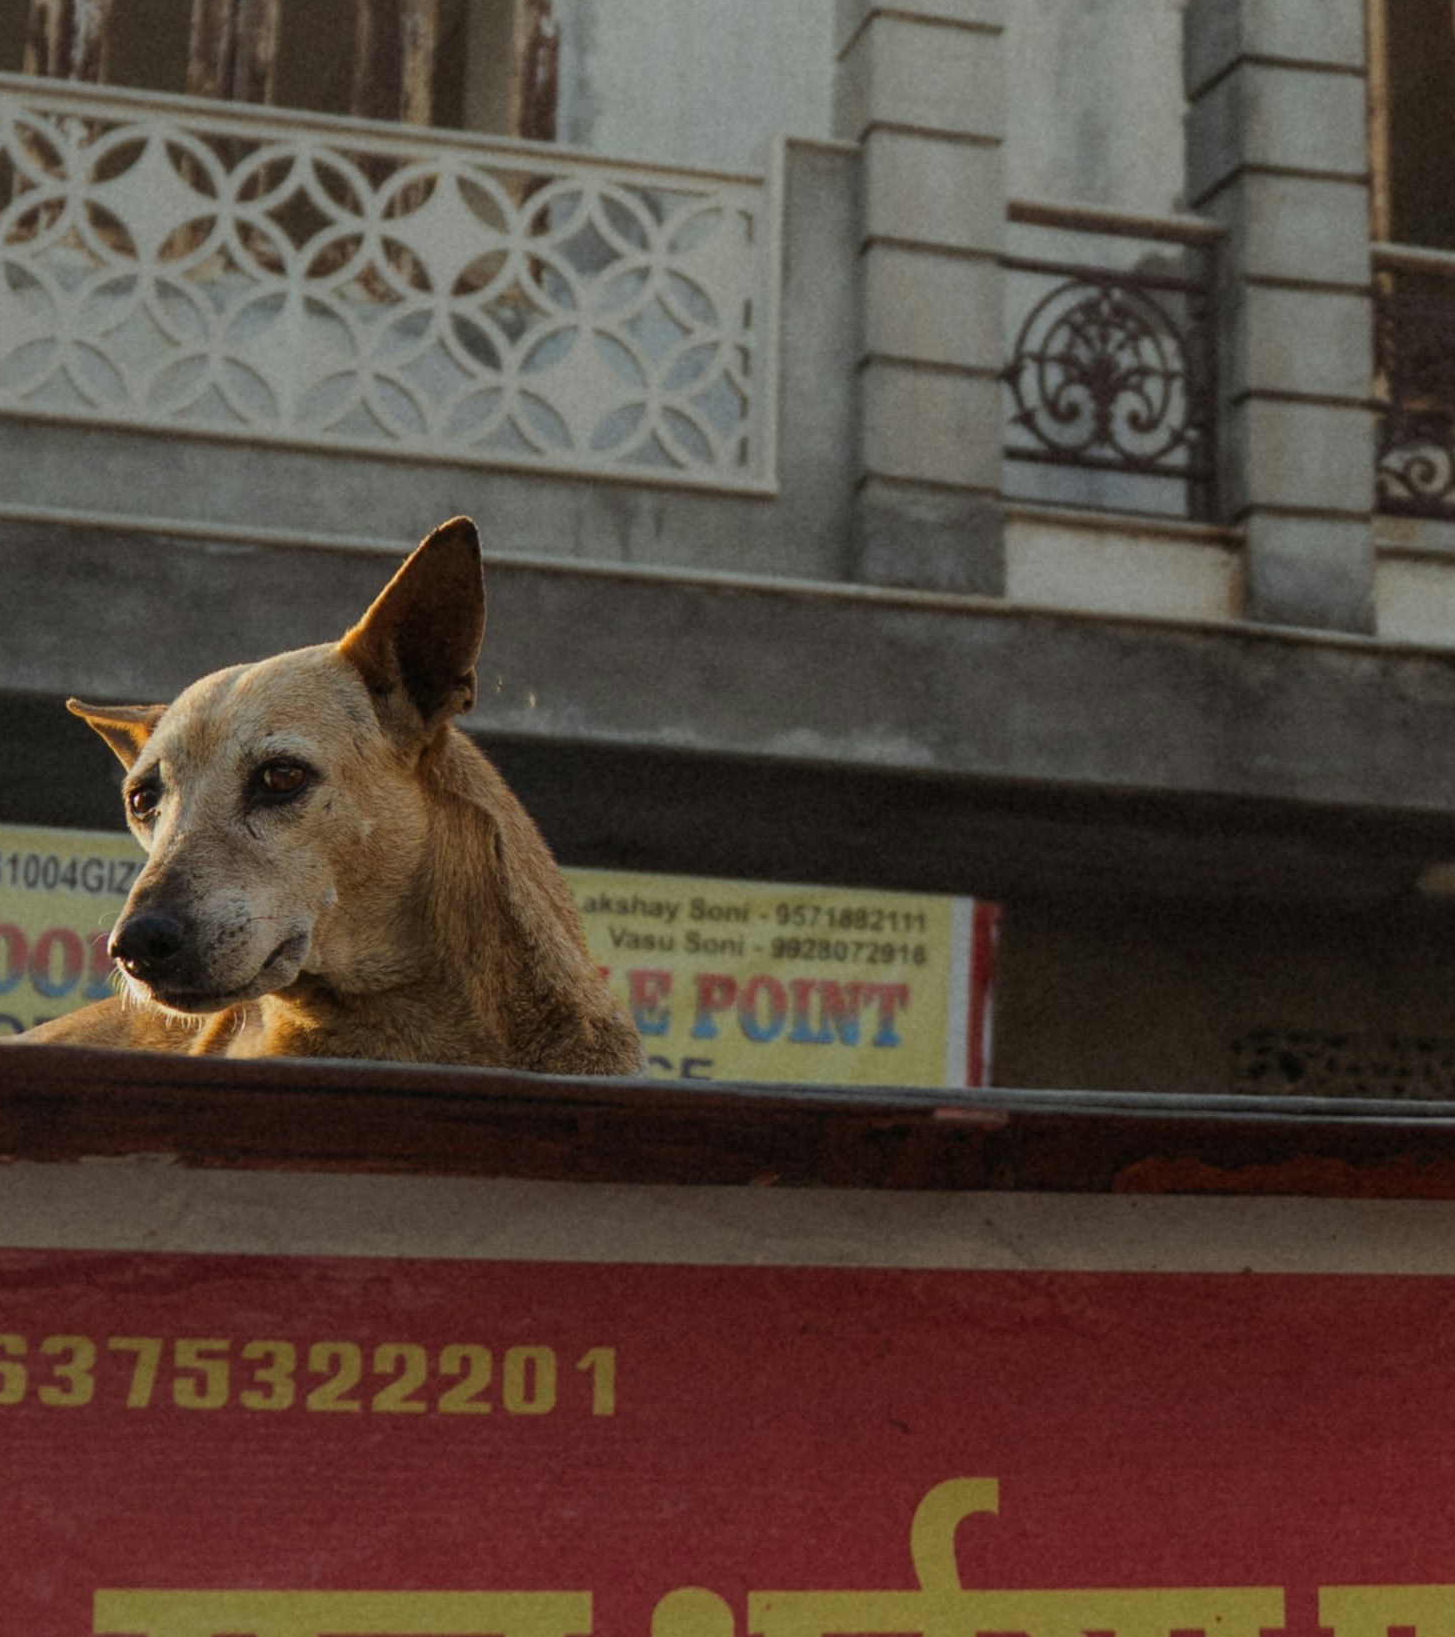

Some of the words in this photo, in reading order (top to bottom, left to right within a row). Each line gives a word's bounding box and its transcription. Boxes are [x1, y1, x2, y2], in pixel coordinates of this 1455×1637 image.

[689, 898, 748, 924] Soni
[609, 926, 674, 952] Vasu
[685, 932, 745, 957] Soni
[692, 973, 911, 1048] POINT
